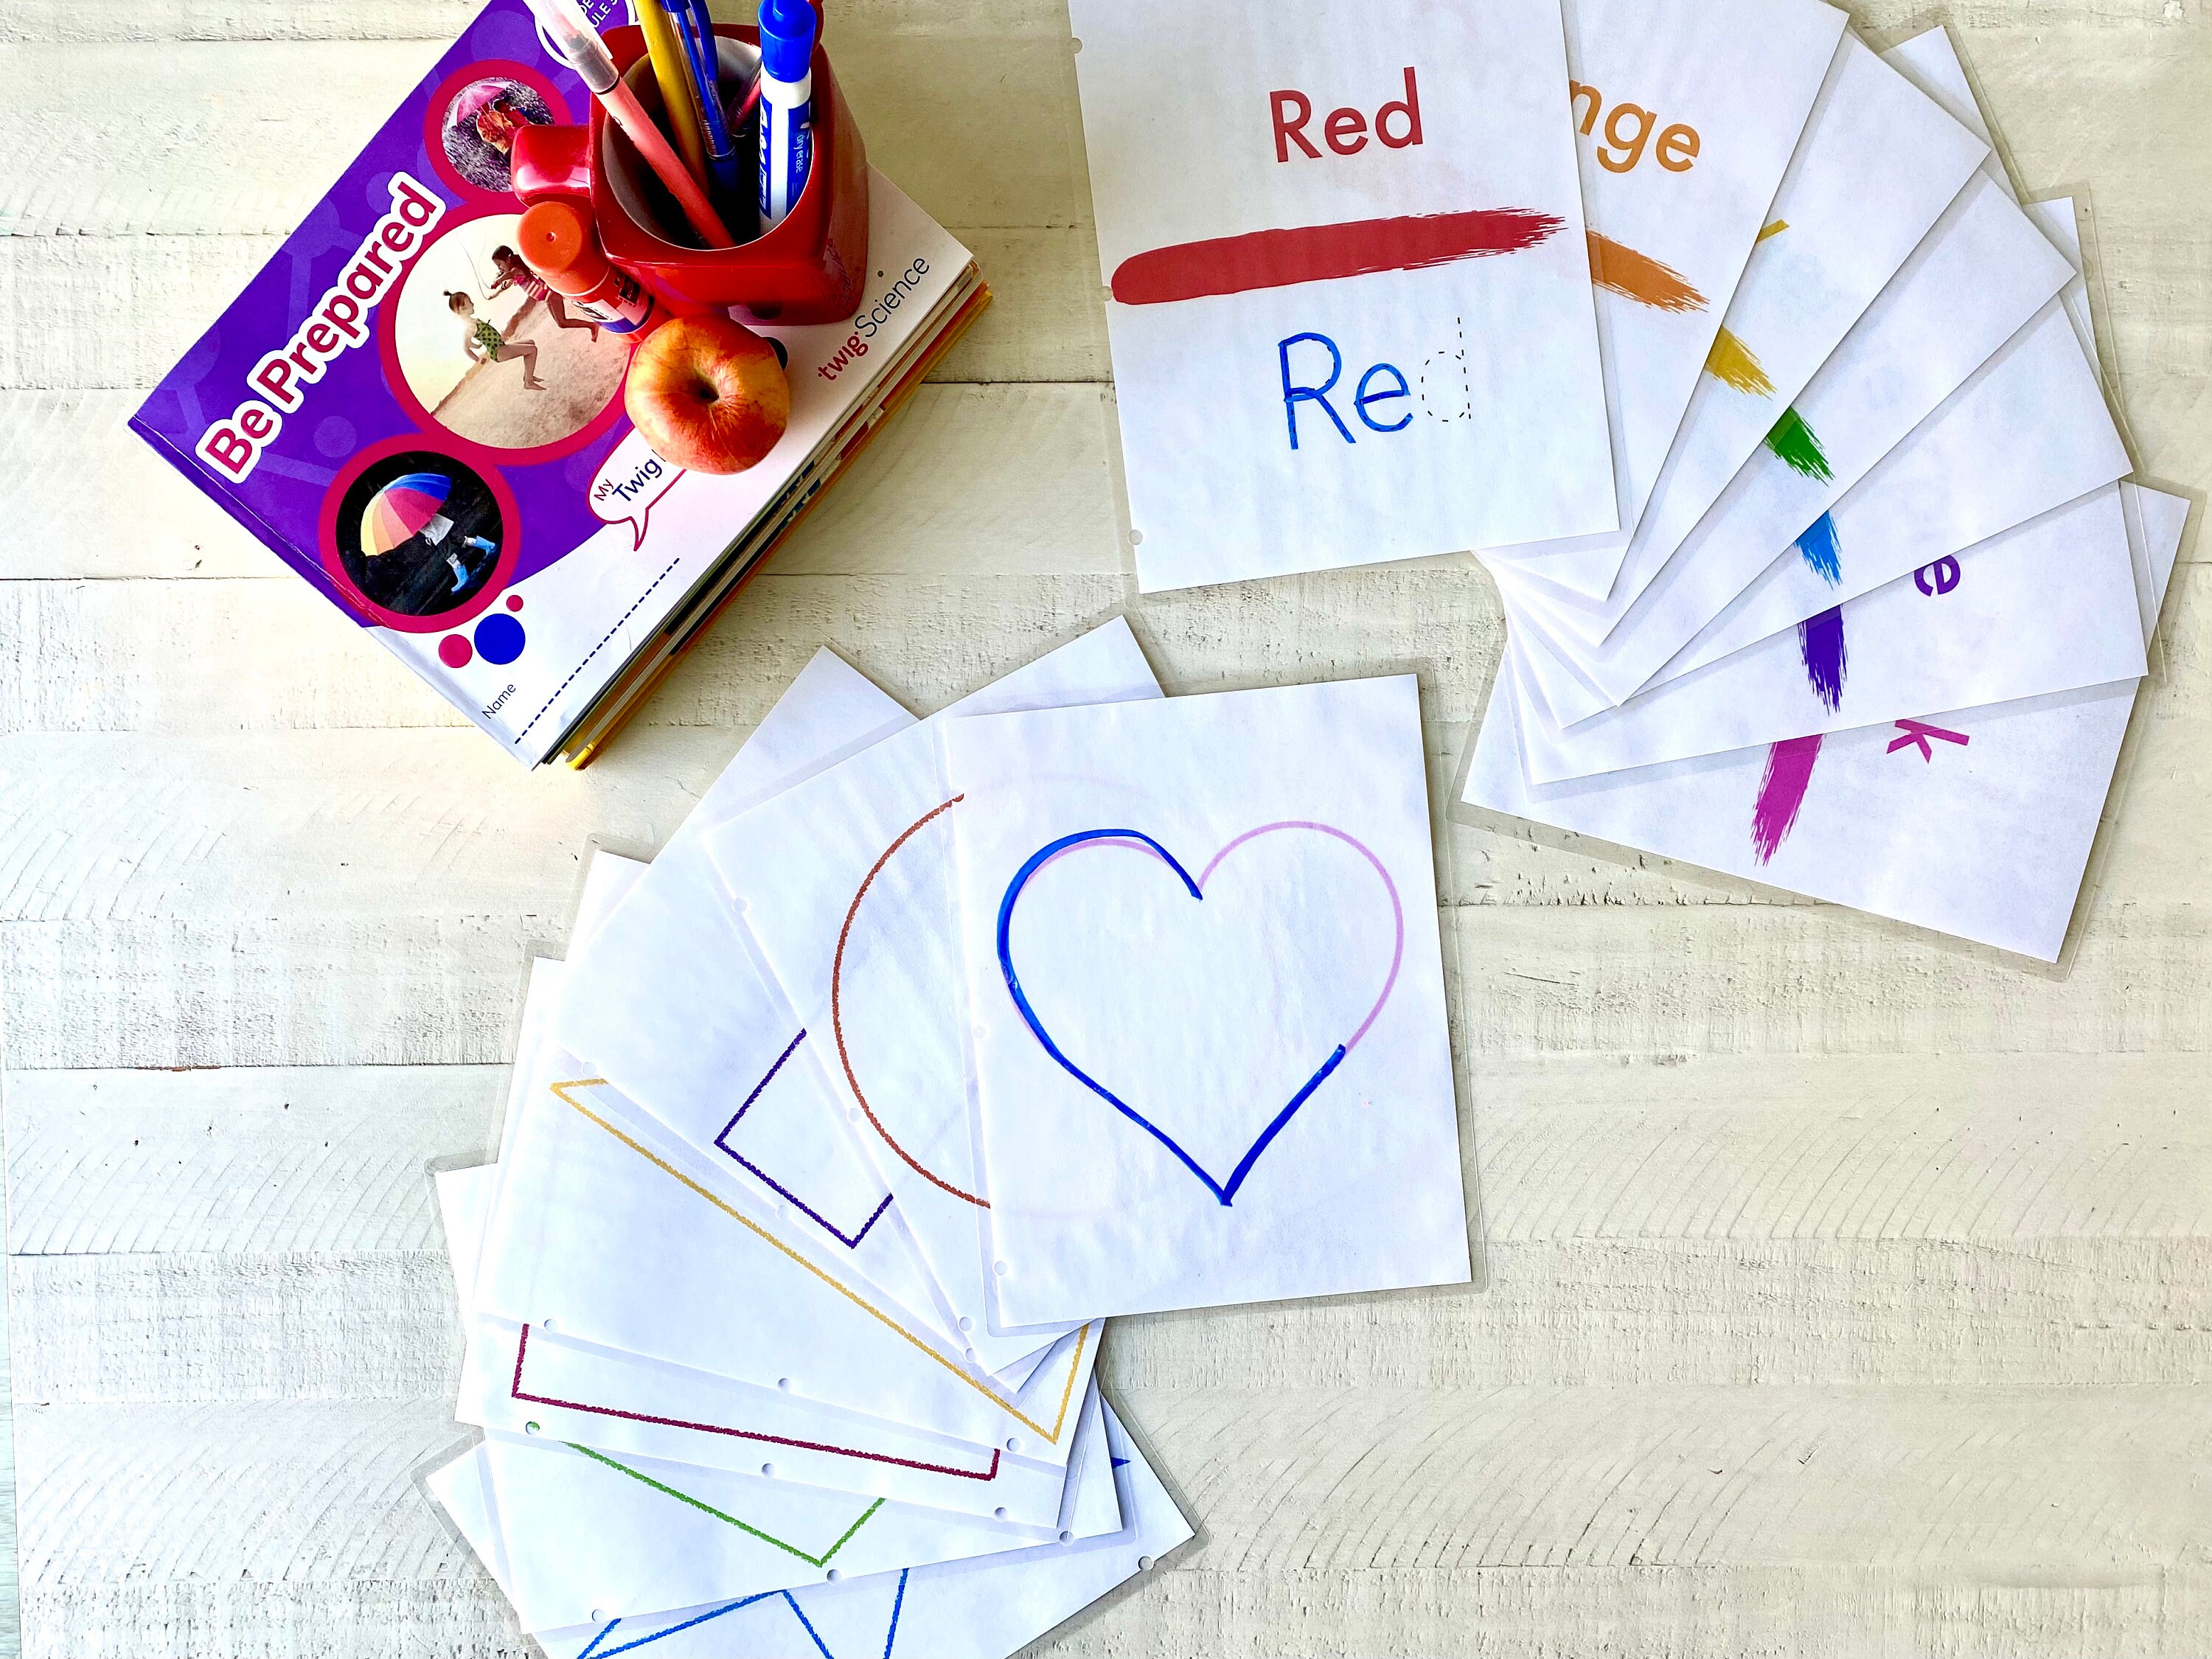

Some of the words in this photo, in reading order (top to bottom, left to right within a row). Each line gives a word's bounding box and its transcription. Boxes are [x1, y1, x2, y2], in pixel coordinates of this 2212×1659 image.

[1270, 66, 1425, 163] Red
[793, 134, 806, 150] dry
[796, 150, 804, 173] erase
[201, 405, 276, 478] Be
[253, 178, 440, 408] Prepared
[1278, 317, 1471, 450] Red
[594, 479, 614, 501] My
[611, 459, 663, 501] Twig
[481, 684, 516, 720] Name
